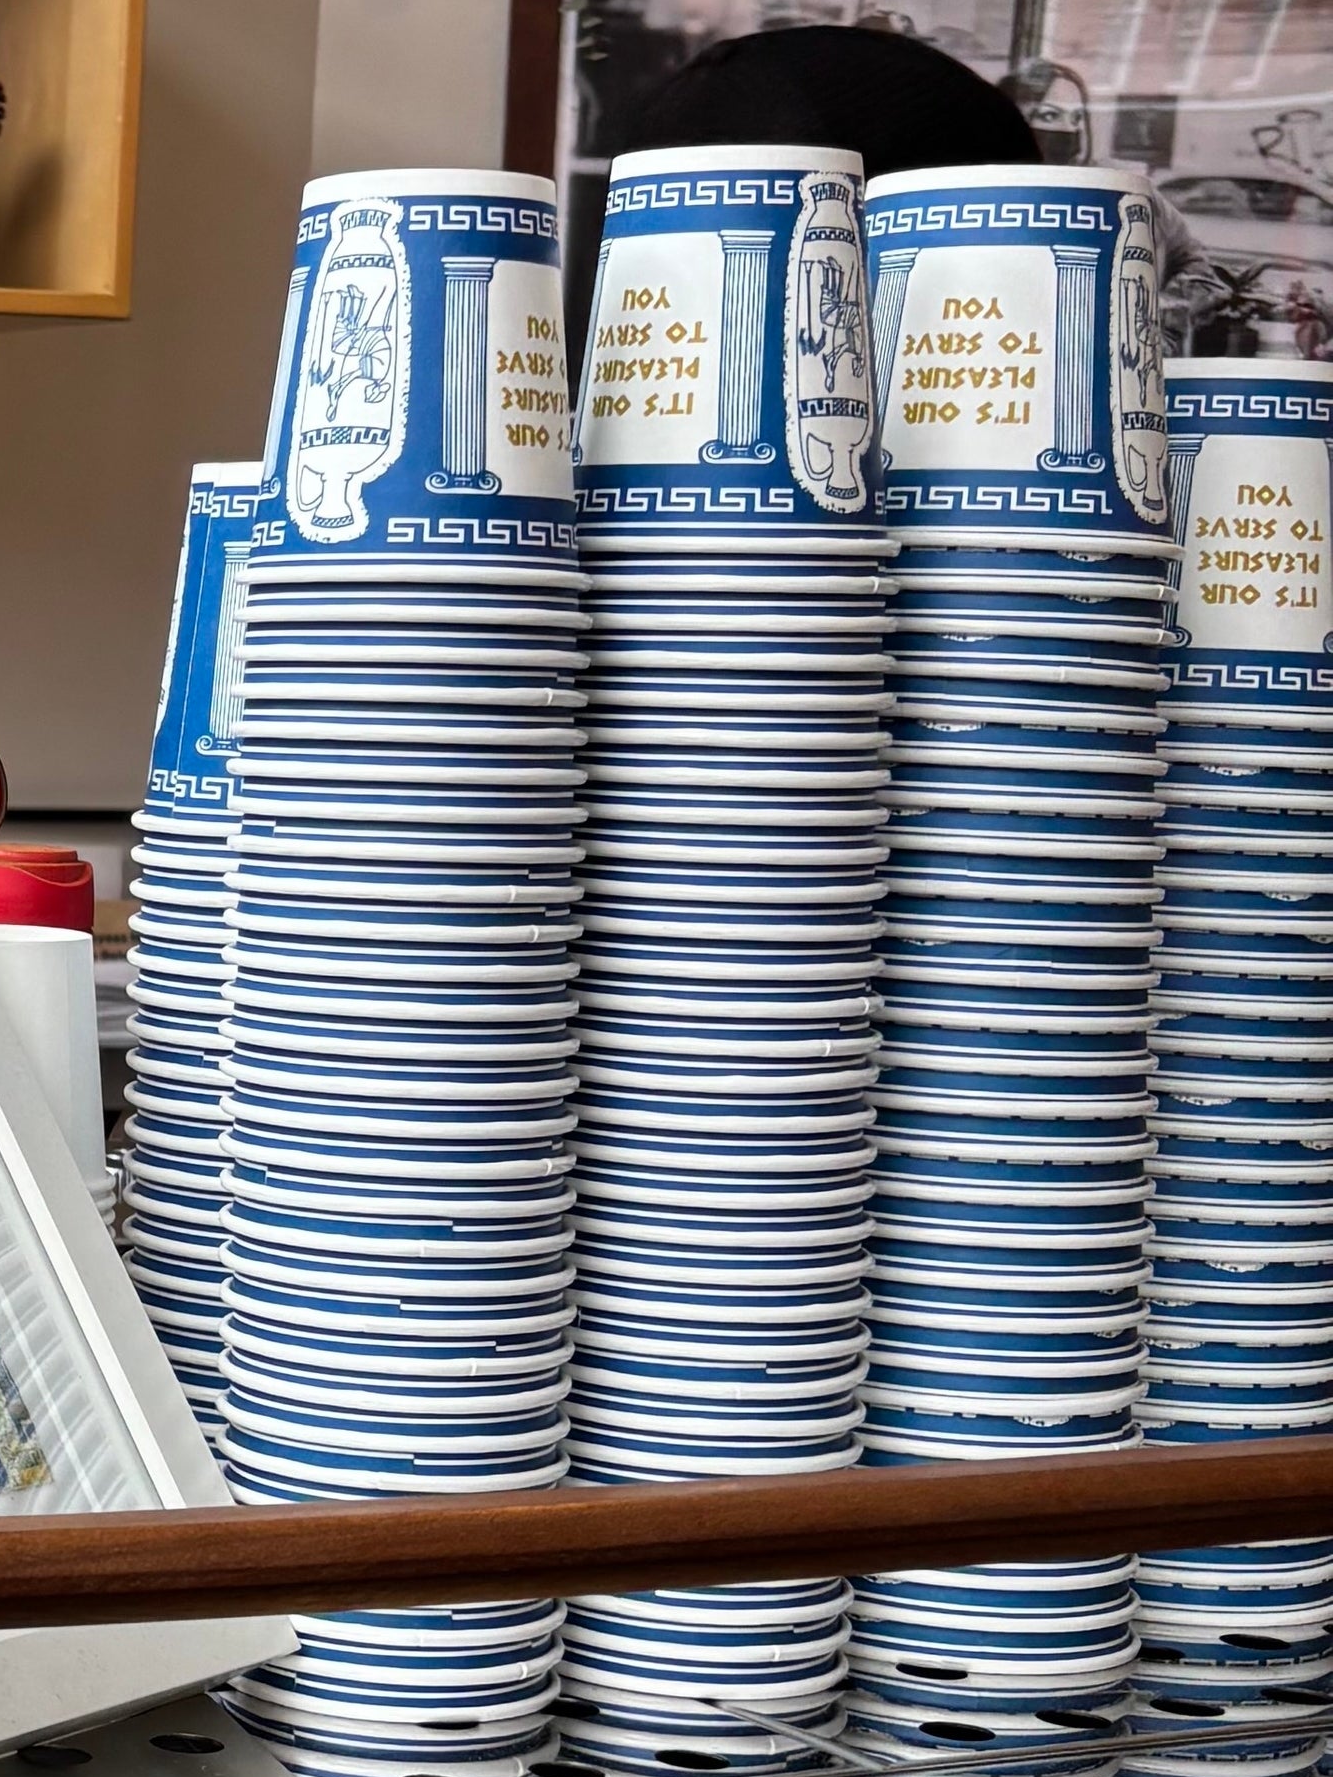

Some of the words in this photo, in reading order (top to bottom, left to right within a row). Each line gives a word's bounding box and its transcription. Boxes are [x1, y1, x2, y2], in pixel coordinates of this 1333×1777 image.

[622, 286, 671, 311] YOU
[943, 297, 1004, 320] YOU
[527, 314, 559, 341] YOU
[597, 322, 653, 348] SERVE
[666, 321, 708, 344] TO
[902, 332, 983, 356] SERVE
[998, 332, 1043, 354] TO
[496, 349, 553, 376] SERVE
[594, 356, 700, 383] PLEASURE
[902, 367, 1035, 390] PLEASURE
[593, 394, 631, 418] OUR
[644, 393, 694, 417] IT'S
[903, 401, 961, 425] OUR
[976, 401, 1030, 425] IT'S
[505, 422, 549, 446] OUR
[1237, 485, 1292, 507] YOU
[1195, 516, 1277, 540] SERVE
[1290, 519, 1323, 541] TO
[1197, 550, 1319, 574] PLEASURE
[1200, 583, 1261, 605] OUR
[1275, 586, 1317, 608] IT'S
